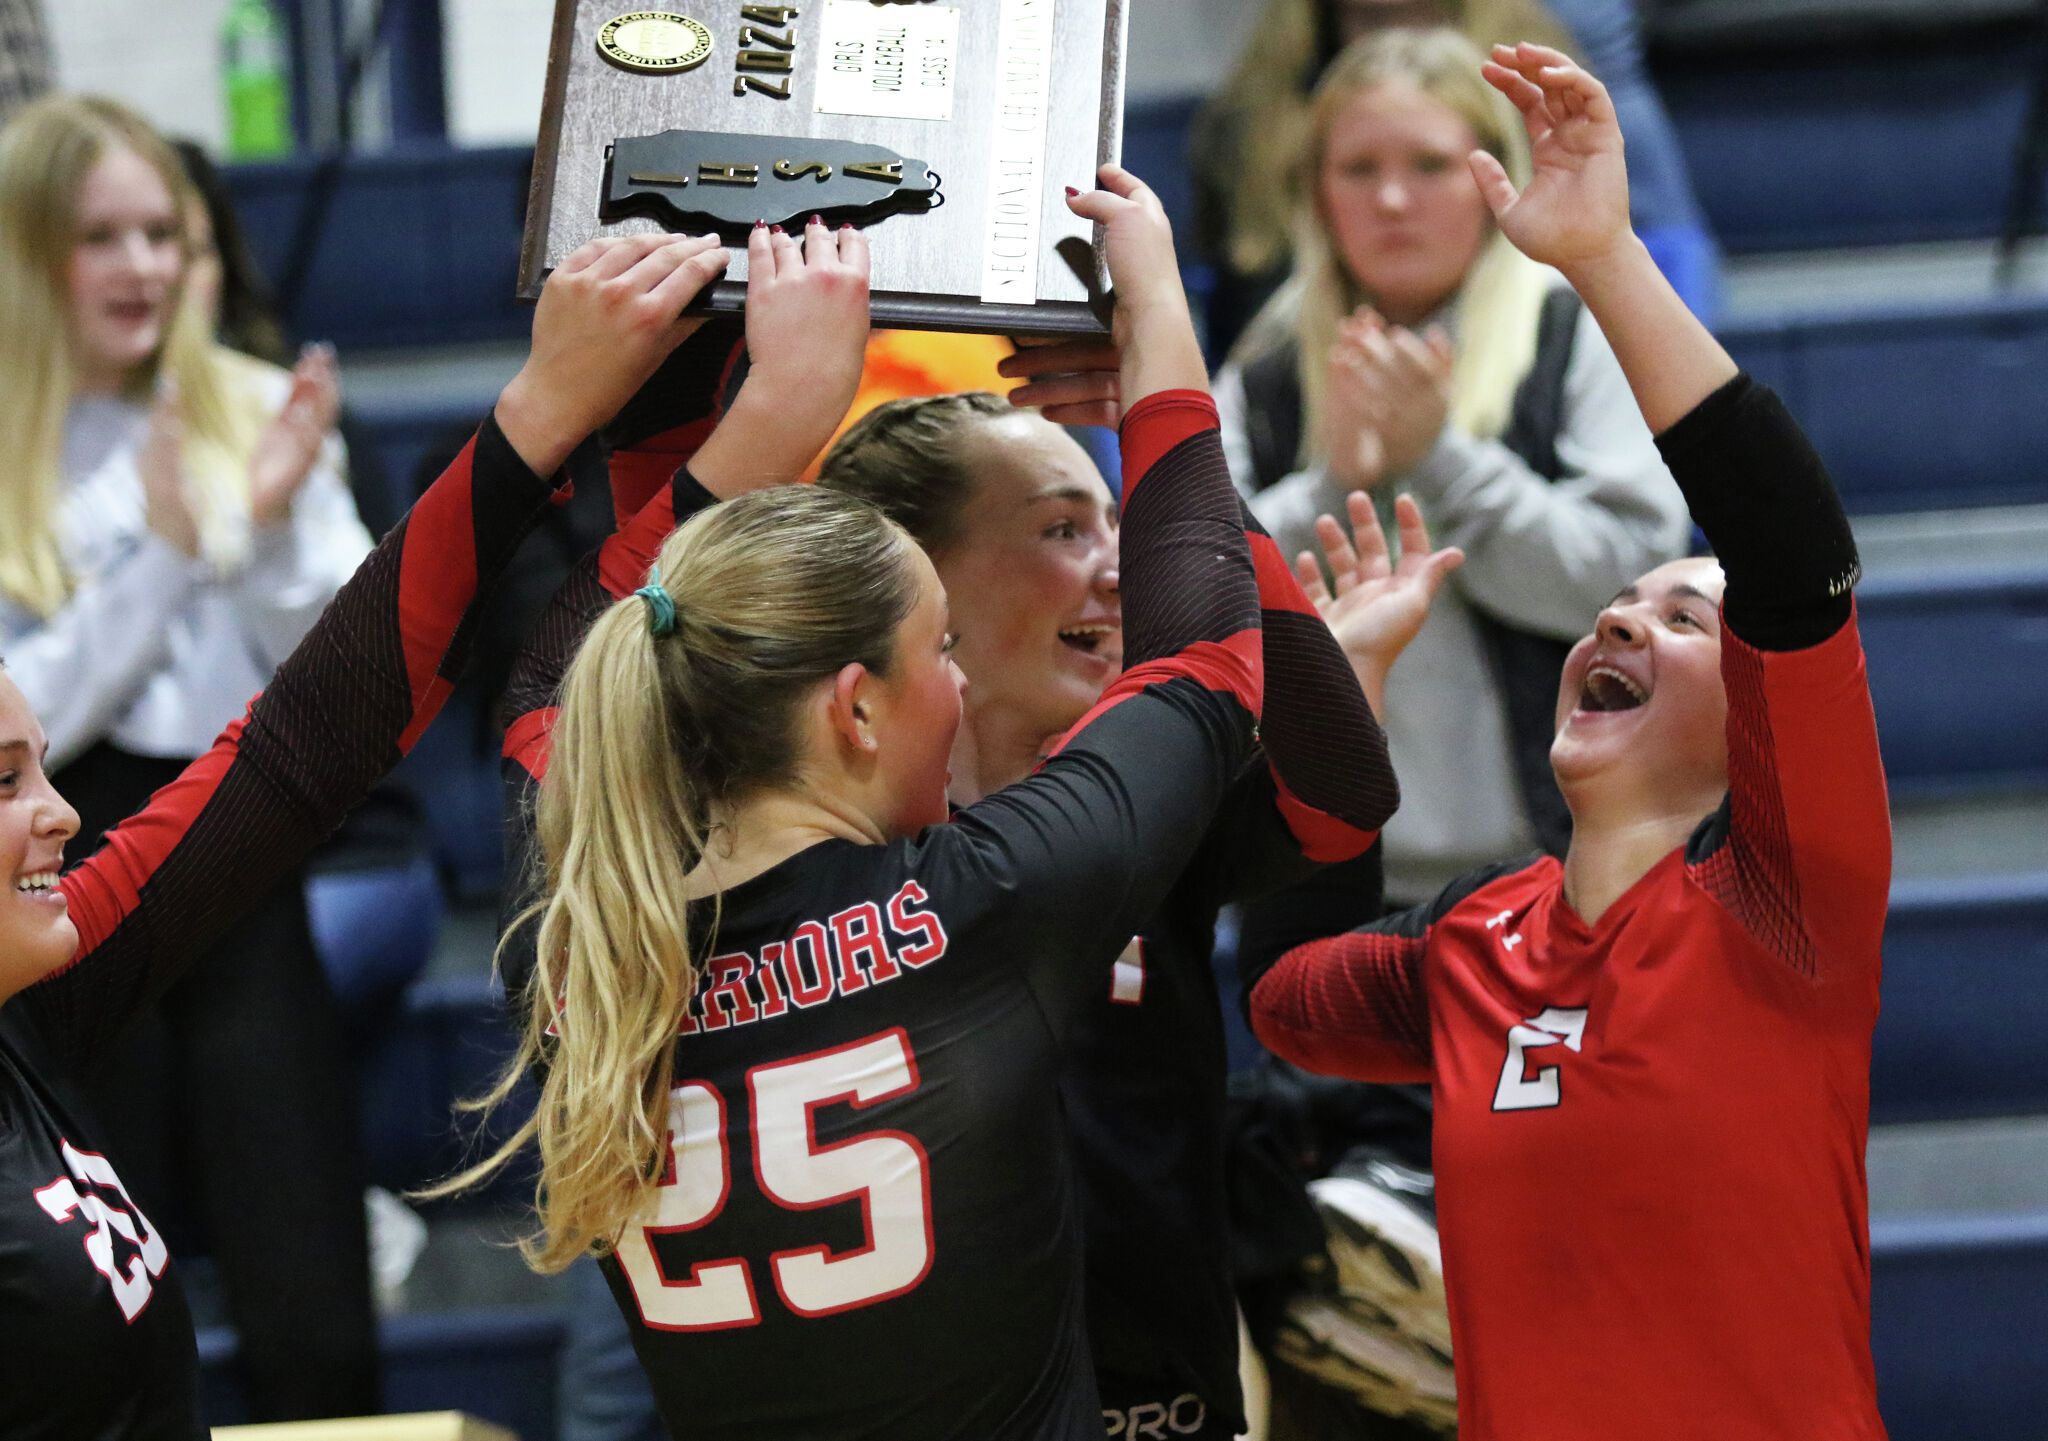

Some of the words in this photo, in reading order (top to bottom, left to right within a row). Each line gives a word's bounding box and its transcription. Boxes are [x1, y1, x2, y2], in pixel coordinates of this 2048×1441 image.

[602, 25, 617, 45] HIGH
[615, 12, 673, 25] SCHOOL
[734, 4, 799, 99] 2024
[833, 41, 865, 73] GIRLS
[872, 28, 906, 91] VOLLEYBALL
[921, 56, 948, 87] CLASS
[629, 158, 904, 188] IHSA
[1491, 1004, 1590, 1113] 2
[610, 1025, 935, 1332] 25
[32, 1136, 170, 1326] 20
